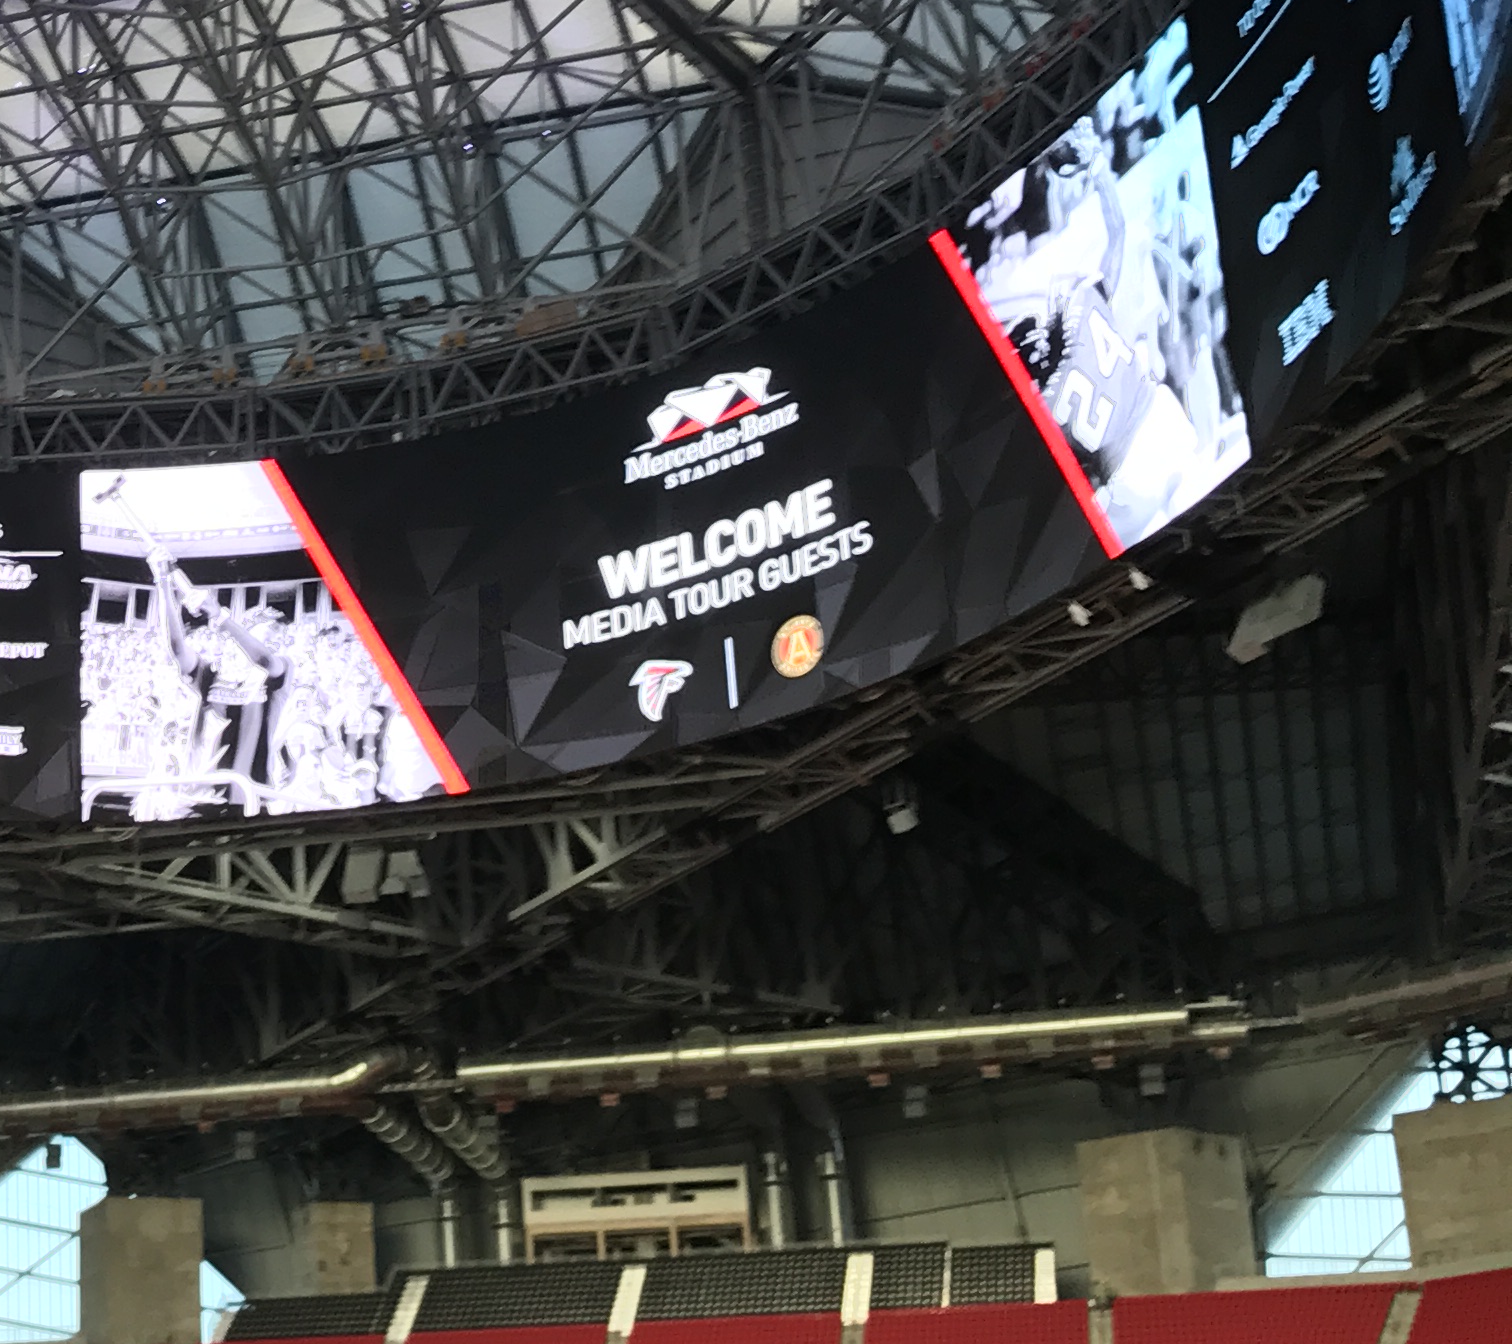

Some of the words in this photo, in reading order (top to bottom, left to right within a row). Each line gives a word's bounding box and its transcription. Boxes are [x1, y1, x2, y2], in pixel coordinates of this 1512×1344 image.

[624, 402, 800, 484] Mercedes-Benz
[664, 441, 765, 490] STADIUM
[562, 598, 668, 649] MEDIA
[668, 568, 755, 620] TOUR
[758, 520, 874, 592] GUESTS
[597, 478, 836, 600] WELCOME
